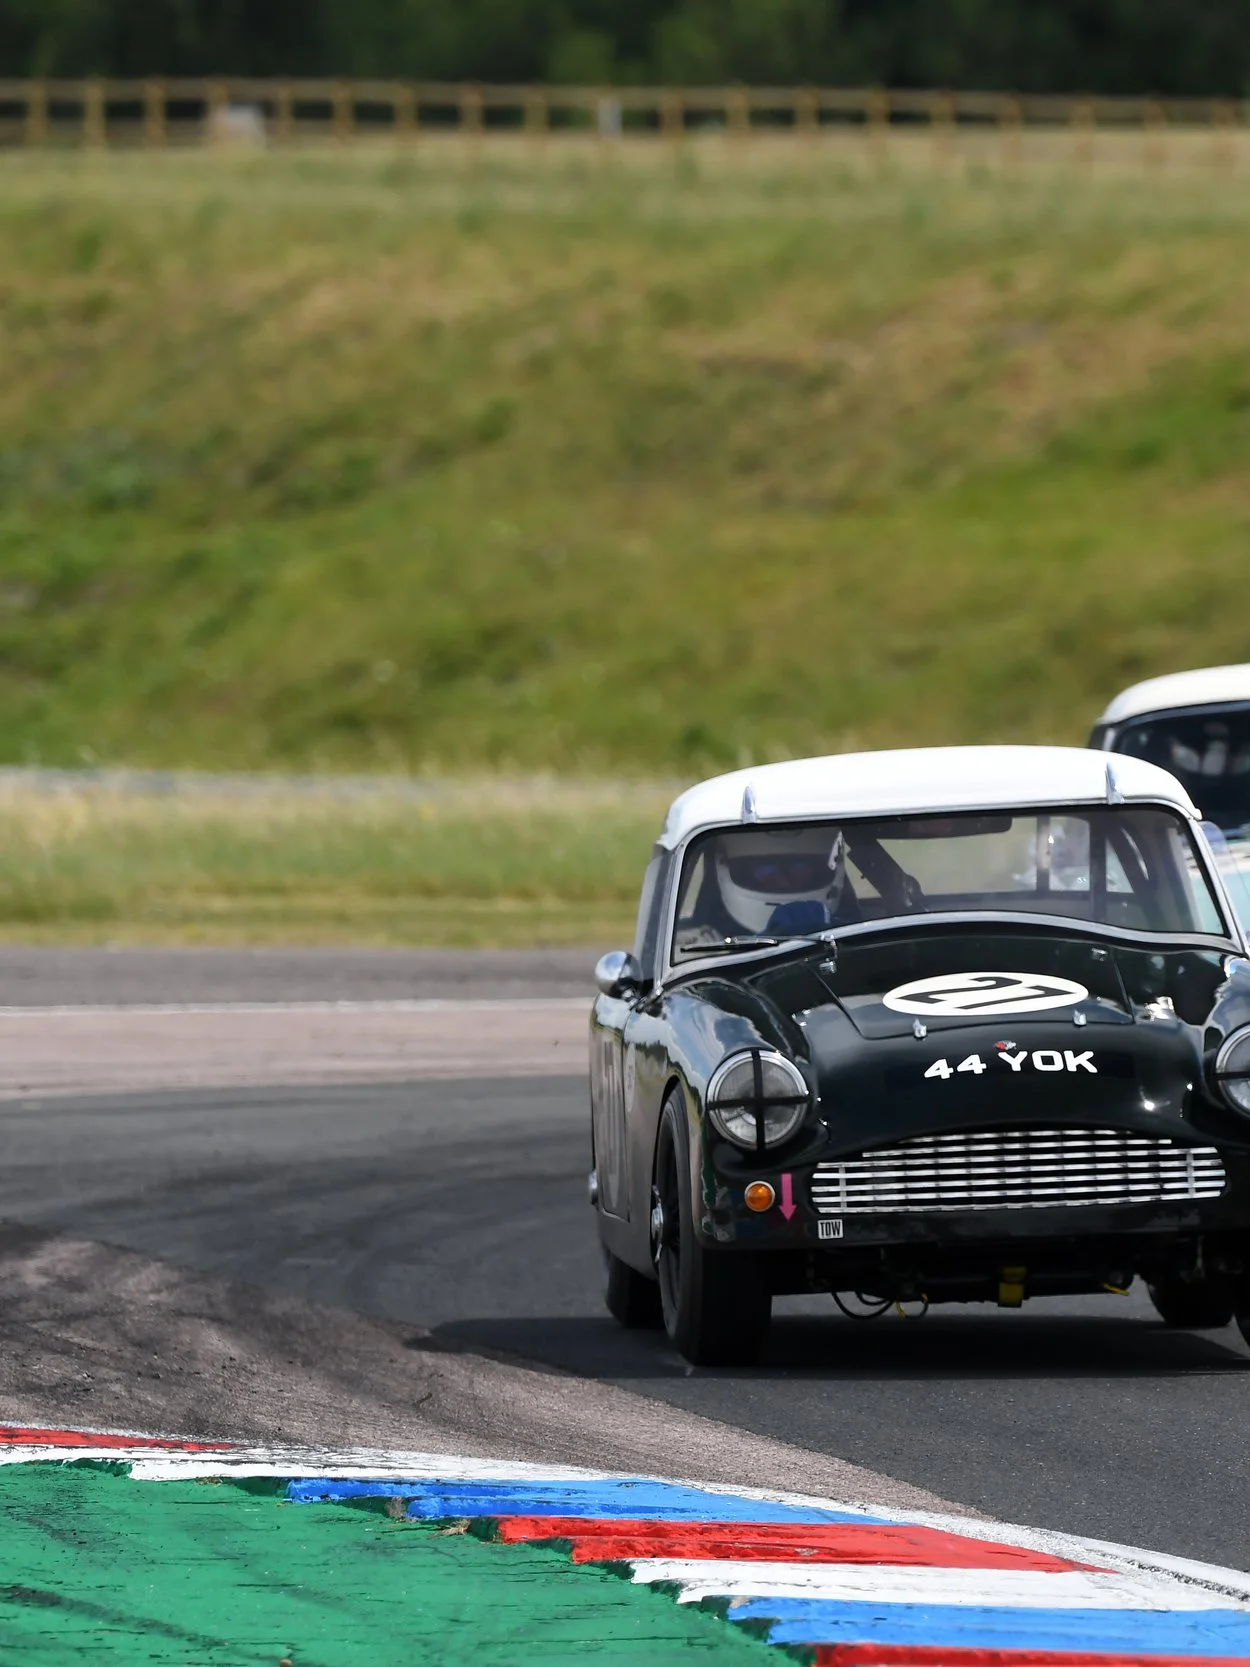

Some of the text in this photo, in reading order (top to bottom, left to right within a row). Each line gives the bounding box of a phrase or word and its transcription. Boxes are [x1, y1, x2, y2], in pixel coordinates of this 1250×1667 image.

[895, 976, 1076, 1010] 27
[924, 1050, 1098, 1079] 44 YOK
[820, 1221, 841, 1238] TOW
